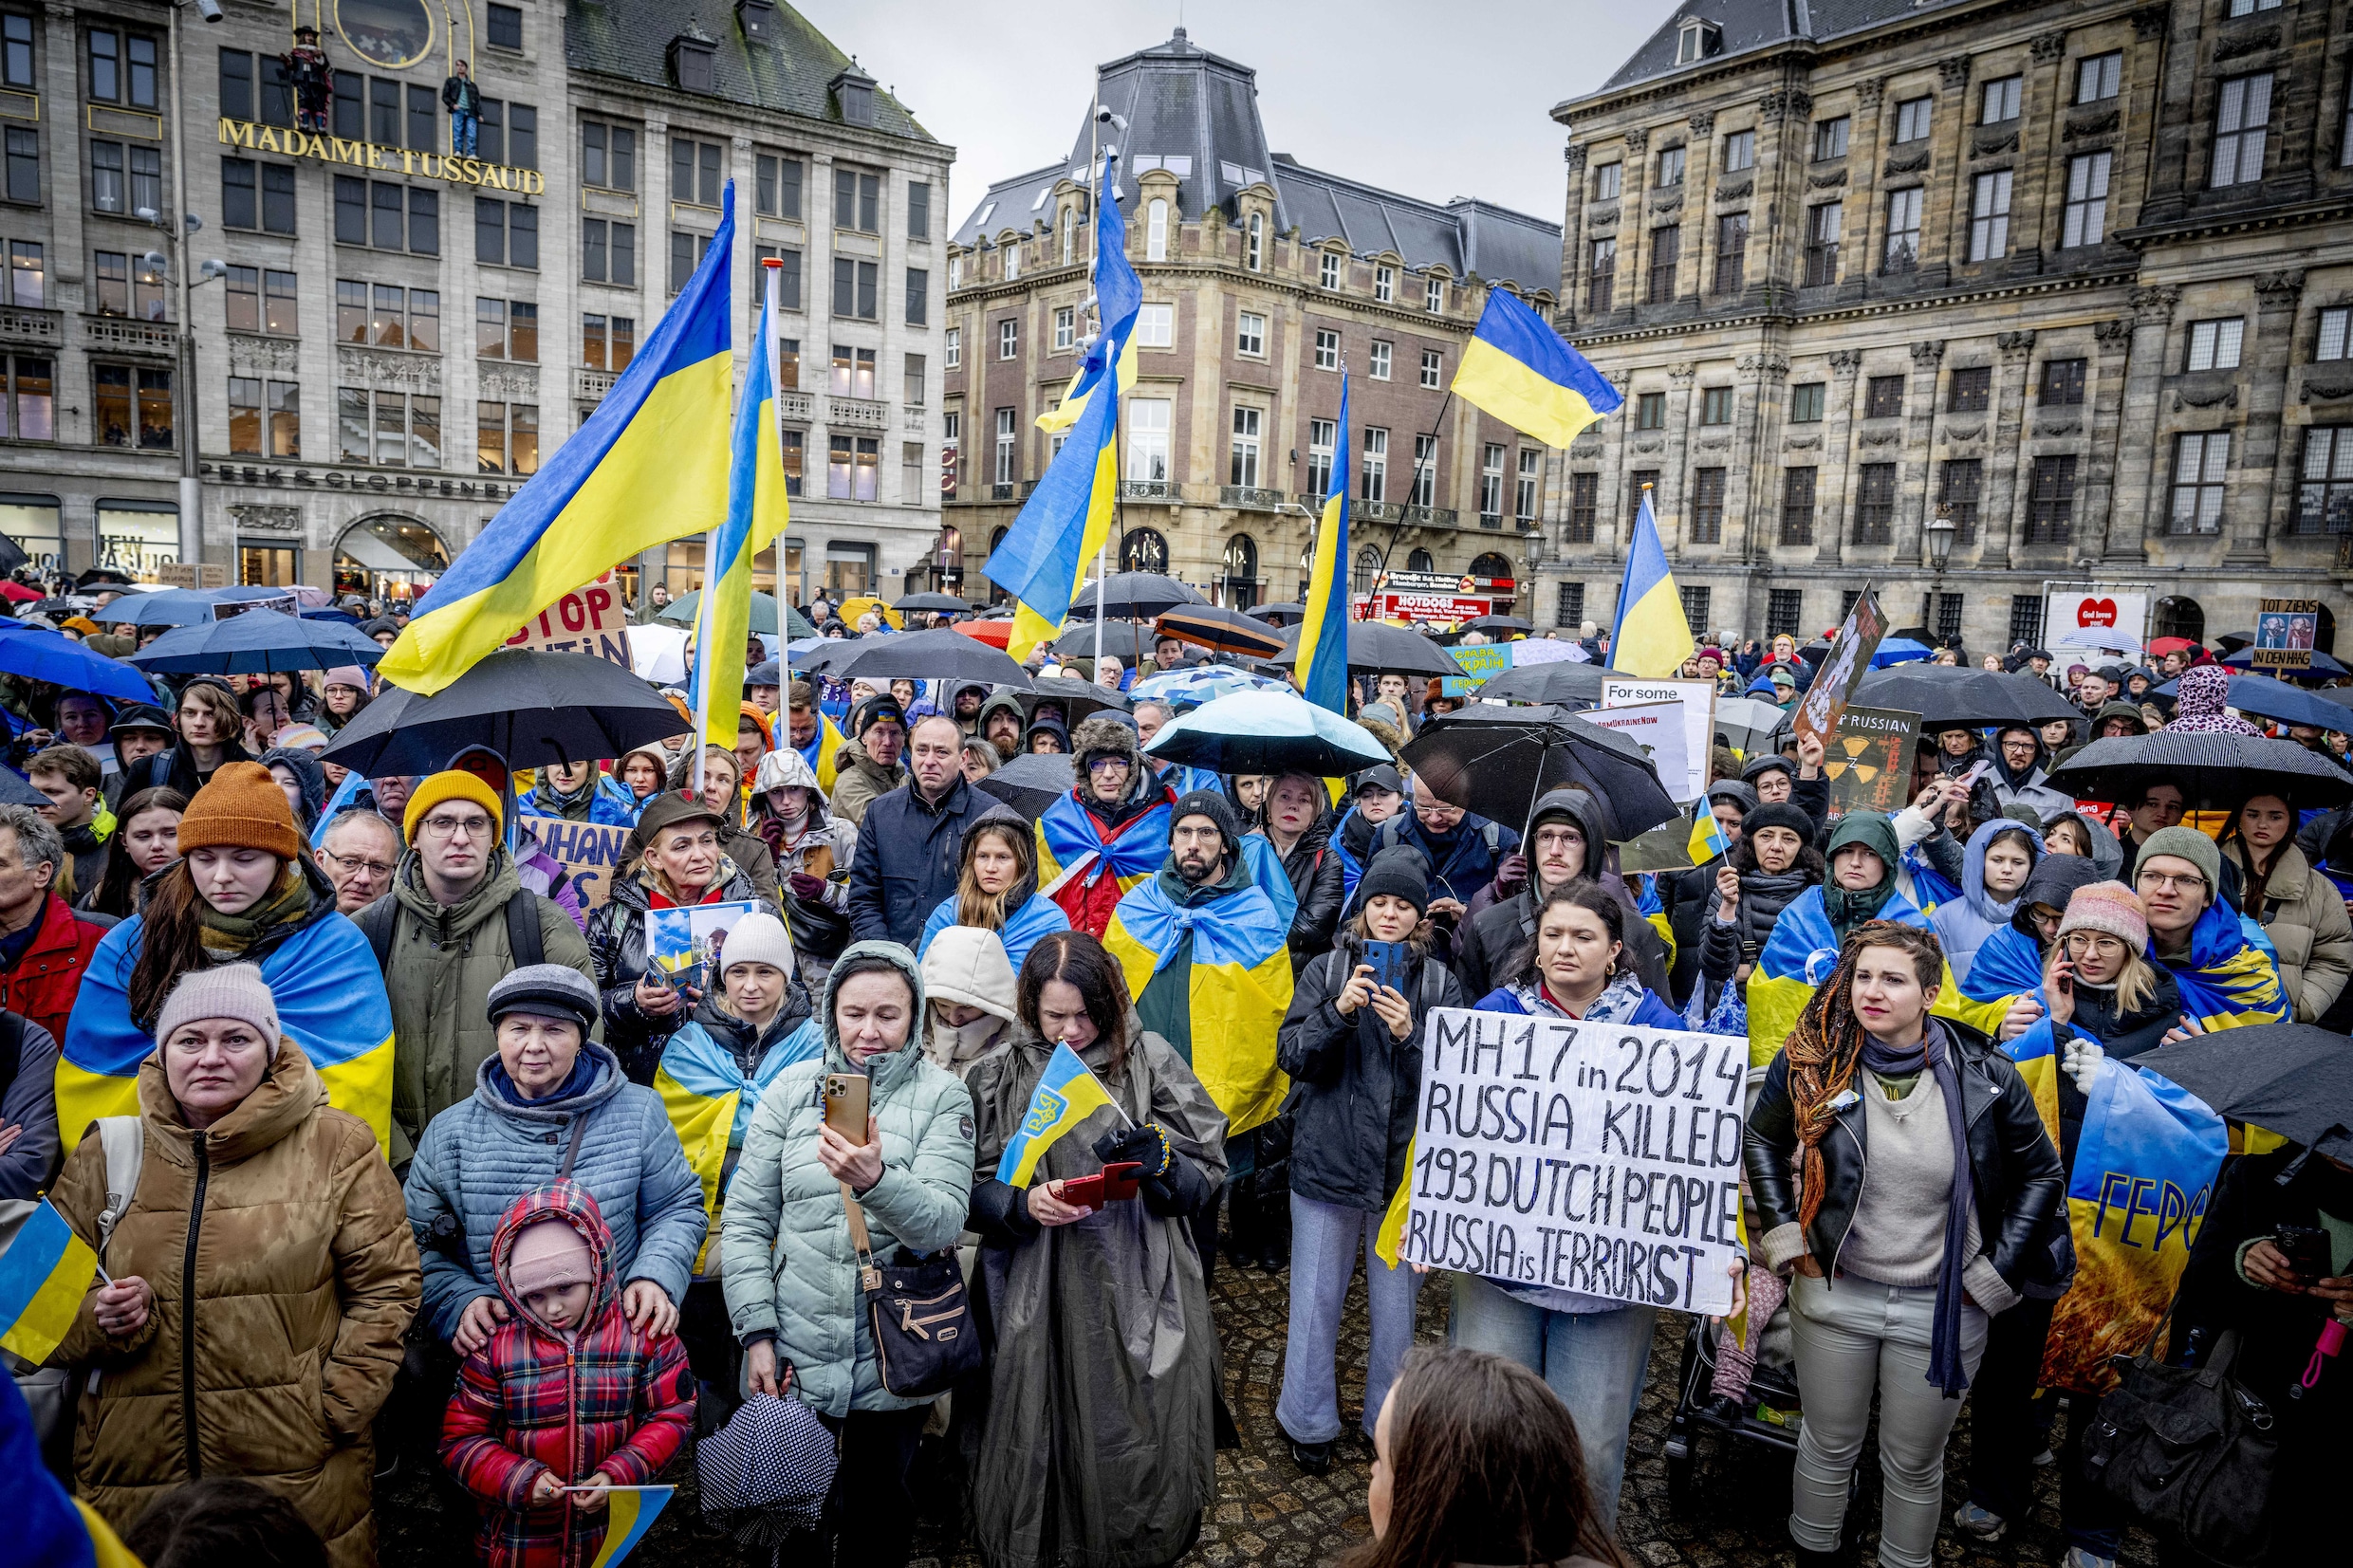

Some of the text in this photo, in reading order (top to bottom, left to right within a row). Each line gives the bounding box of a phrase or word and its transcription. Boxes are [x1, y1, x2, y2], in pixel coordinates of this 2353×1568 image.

[220, 118, 544, 195] MADAME TUSSAUD
[199, 463, 283, 484] PEEK
[294, 470, 316, 486] &
[1390, 573, 1421, 581] Broodje
[1392, 580, 1429, 588] Hamburger,
[1399, 596, 1454, 609] HOTDOGS
[2261, 599, 2282, 612] TOT
[2083, 610, 2112, 618] God loves
[2266, 651, 2286, 664] DEN
[2287, 652, 2310, 665] HAAG
[1608, 685, 1677, 699] For some
[1851, 715, 1911, 733] RUSSIAN
[1846, 756, 1859, 769] Z
[1434, 1013, 1744, 1106] MH17 in 2014
[1425, 1079, 1742, 1169] RUSSIA KILLED
[1416, 1146, 1740, 1247] 193 DUTCH PEOPLE
[1406, 1208, 1706, 1309] RUSSIA is TERRORIST
